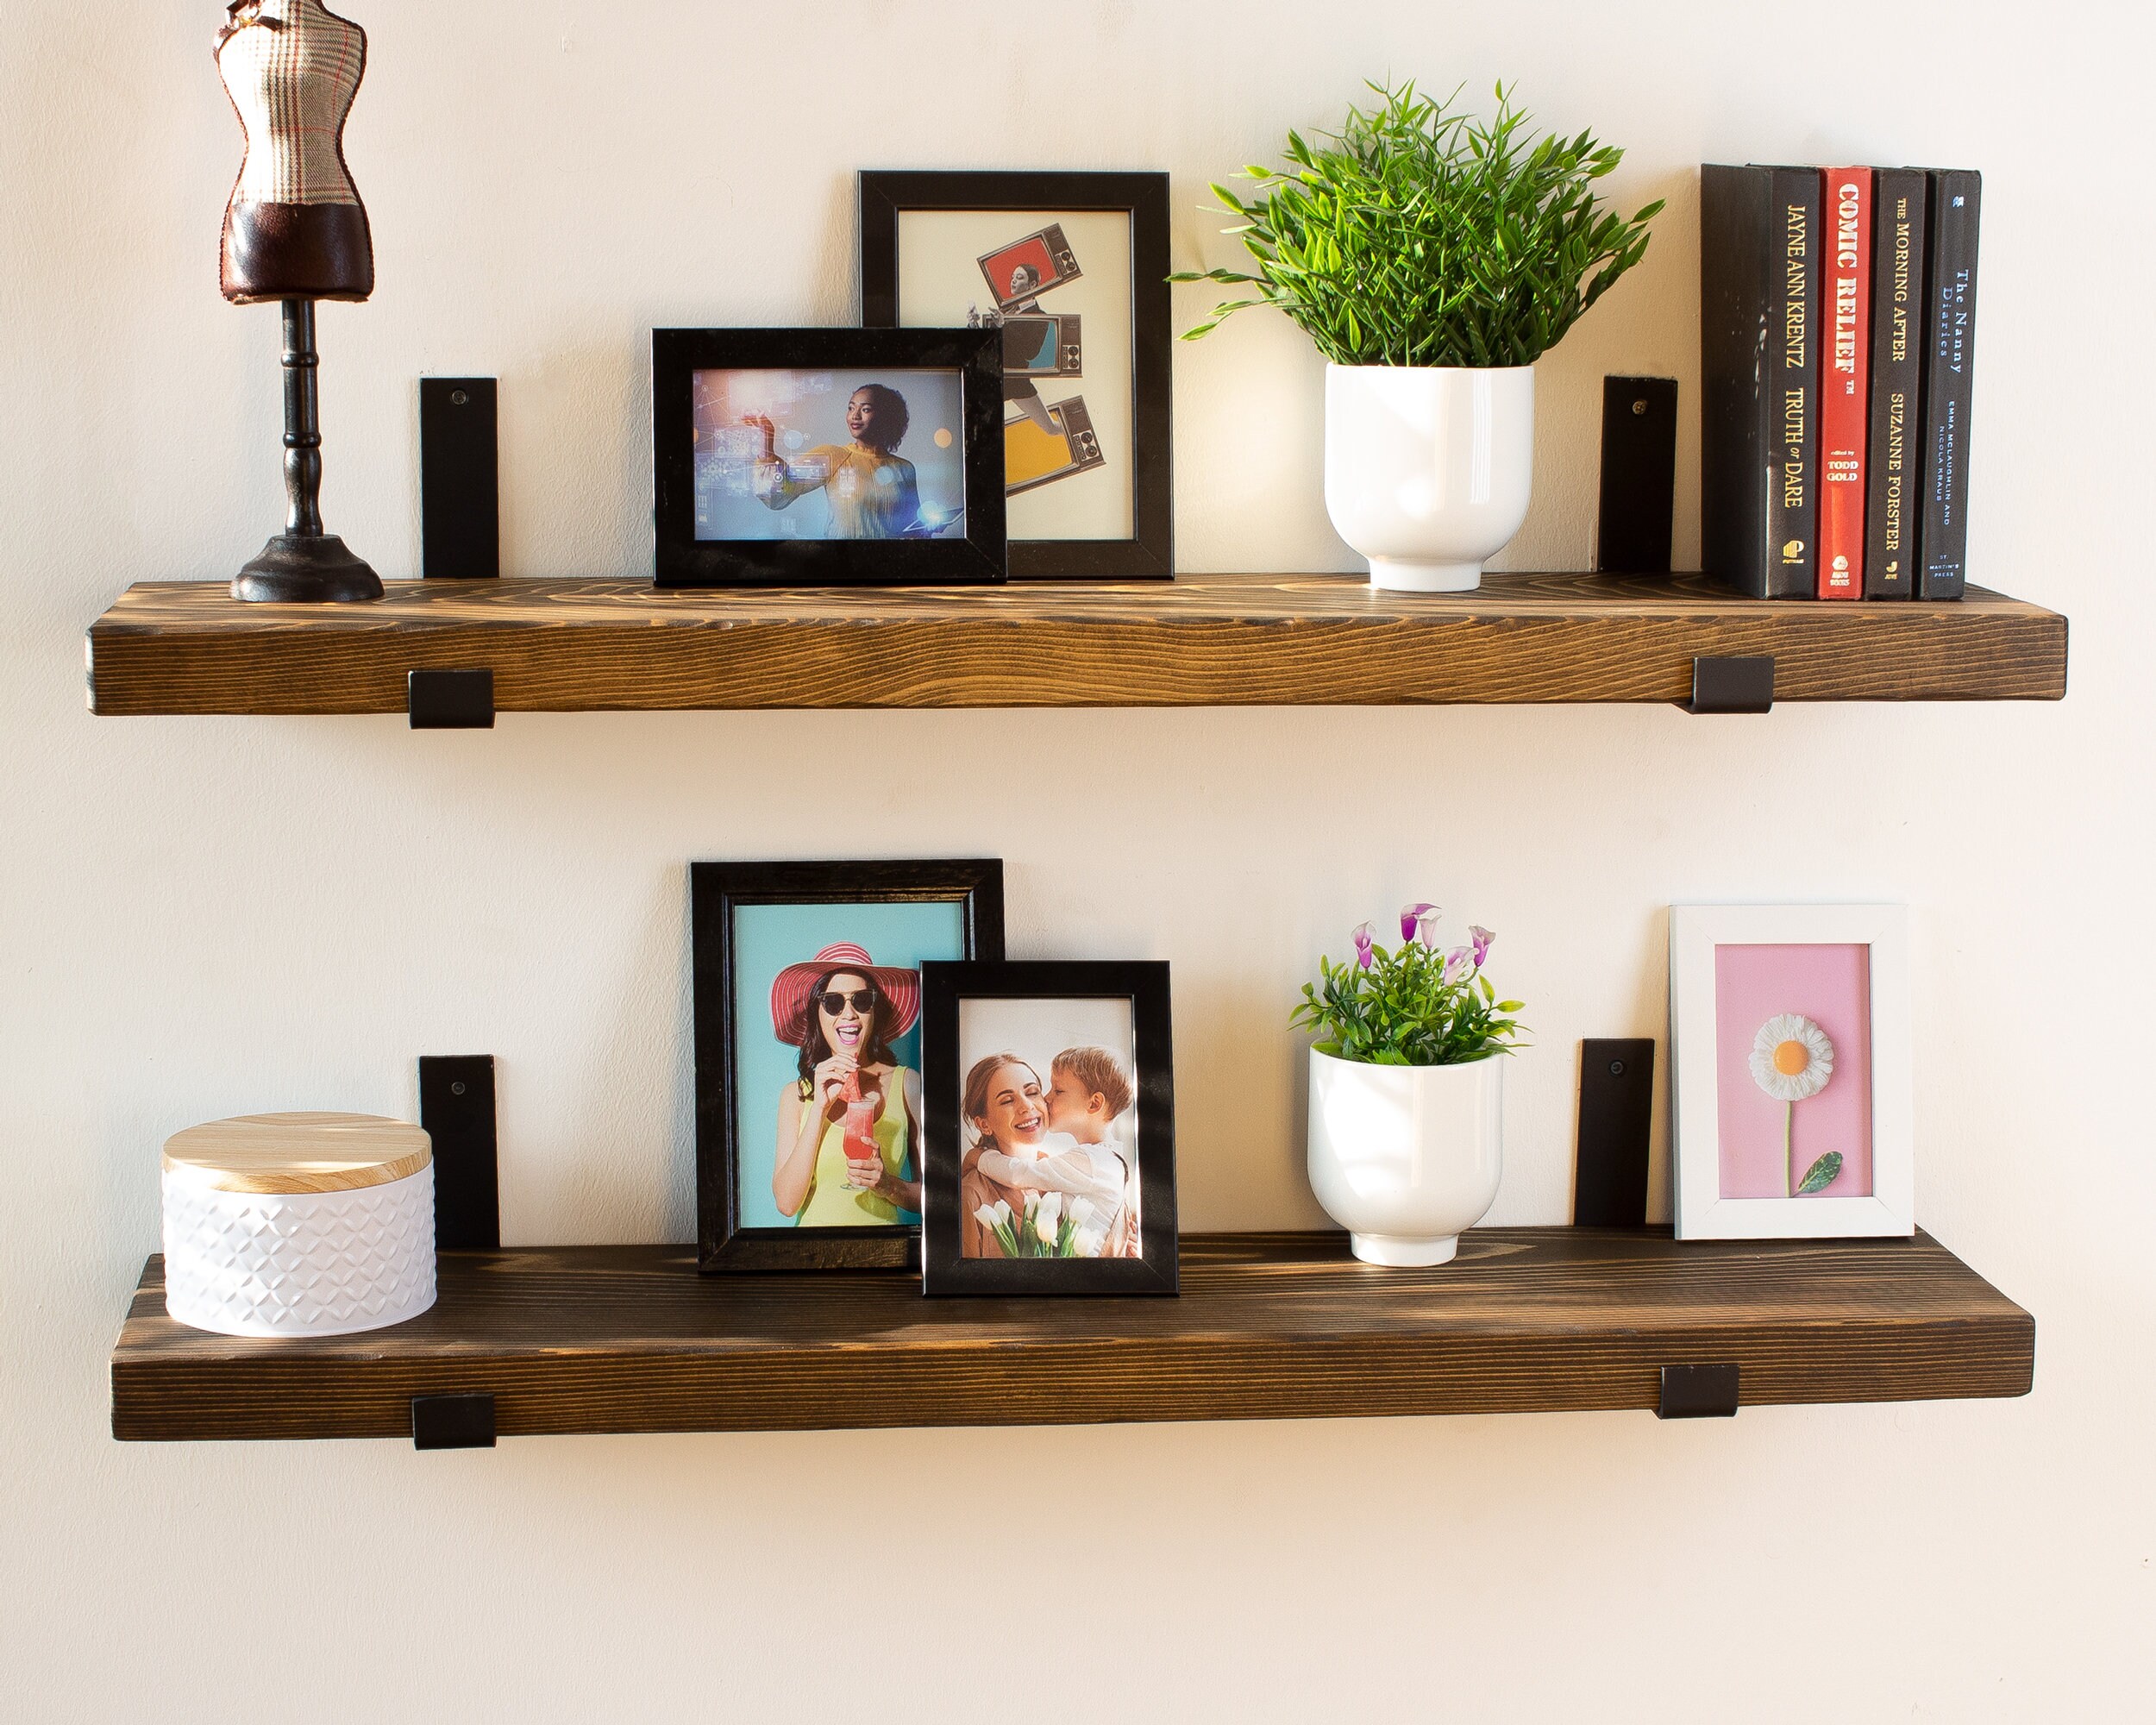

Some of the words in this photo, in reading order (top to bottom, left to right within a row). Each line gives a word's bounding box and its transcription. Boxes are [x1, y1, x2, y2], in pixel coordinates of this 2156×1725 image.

[1787, 204, 1806, 257] JAYNE
[1837, 183, 1859, 268] COMIC
[1897, 198, 1907, 220] THE
[1787, 260, 1805, 298] ANN
[1894, 223, 1909, 303] MORNING
[1956, 269, 1969, 303] The
[1786, 301, 1805, 368] KRENTZ
[1835, 278, 1858, 373] RELIEF
[1892, 307, 1907, 362] AFTER
[1940, 286, 1953, 357] Diaries
[1951, 311, 1966, 373] Nanny
[1785, 387, 1804, 444] TRUTH
[1889, 393, 1903, 471] SUZANNE
[1790, 447, 1800, 460] or
[1827, 461, 1859, 470] TODD
[1827, 473, 1858, 482] GOLD
[1945, 434, 1953, 500] MCLAUGHLIN
[1784, 461, 1803, 508] DARE
[1886, 475, 1901, 551] FORSTER
